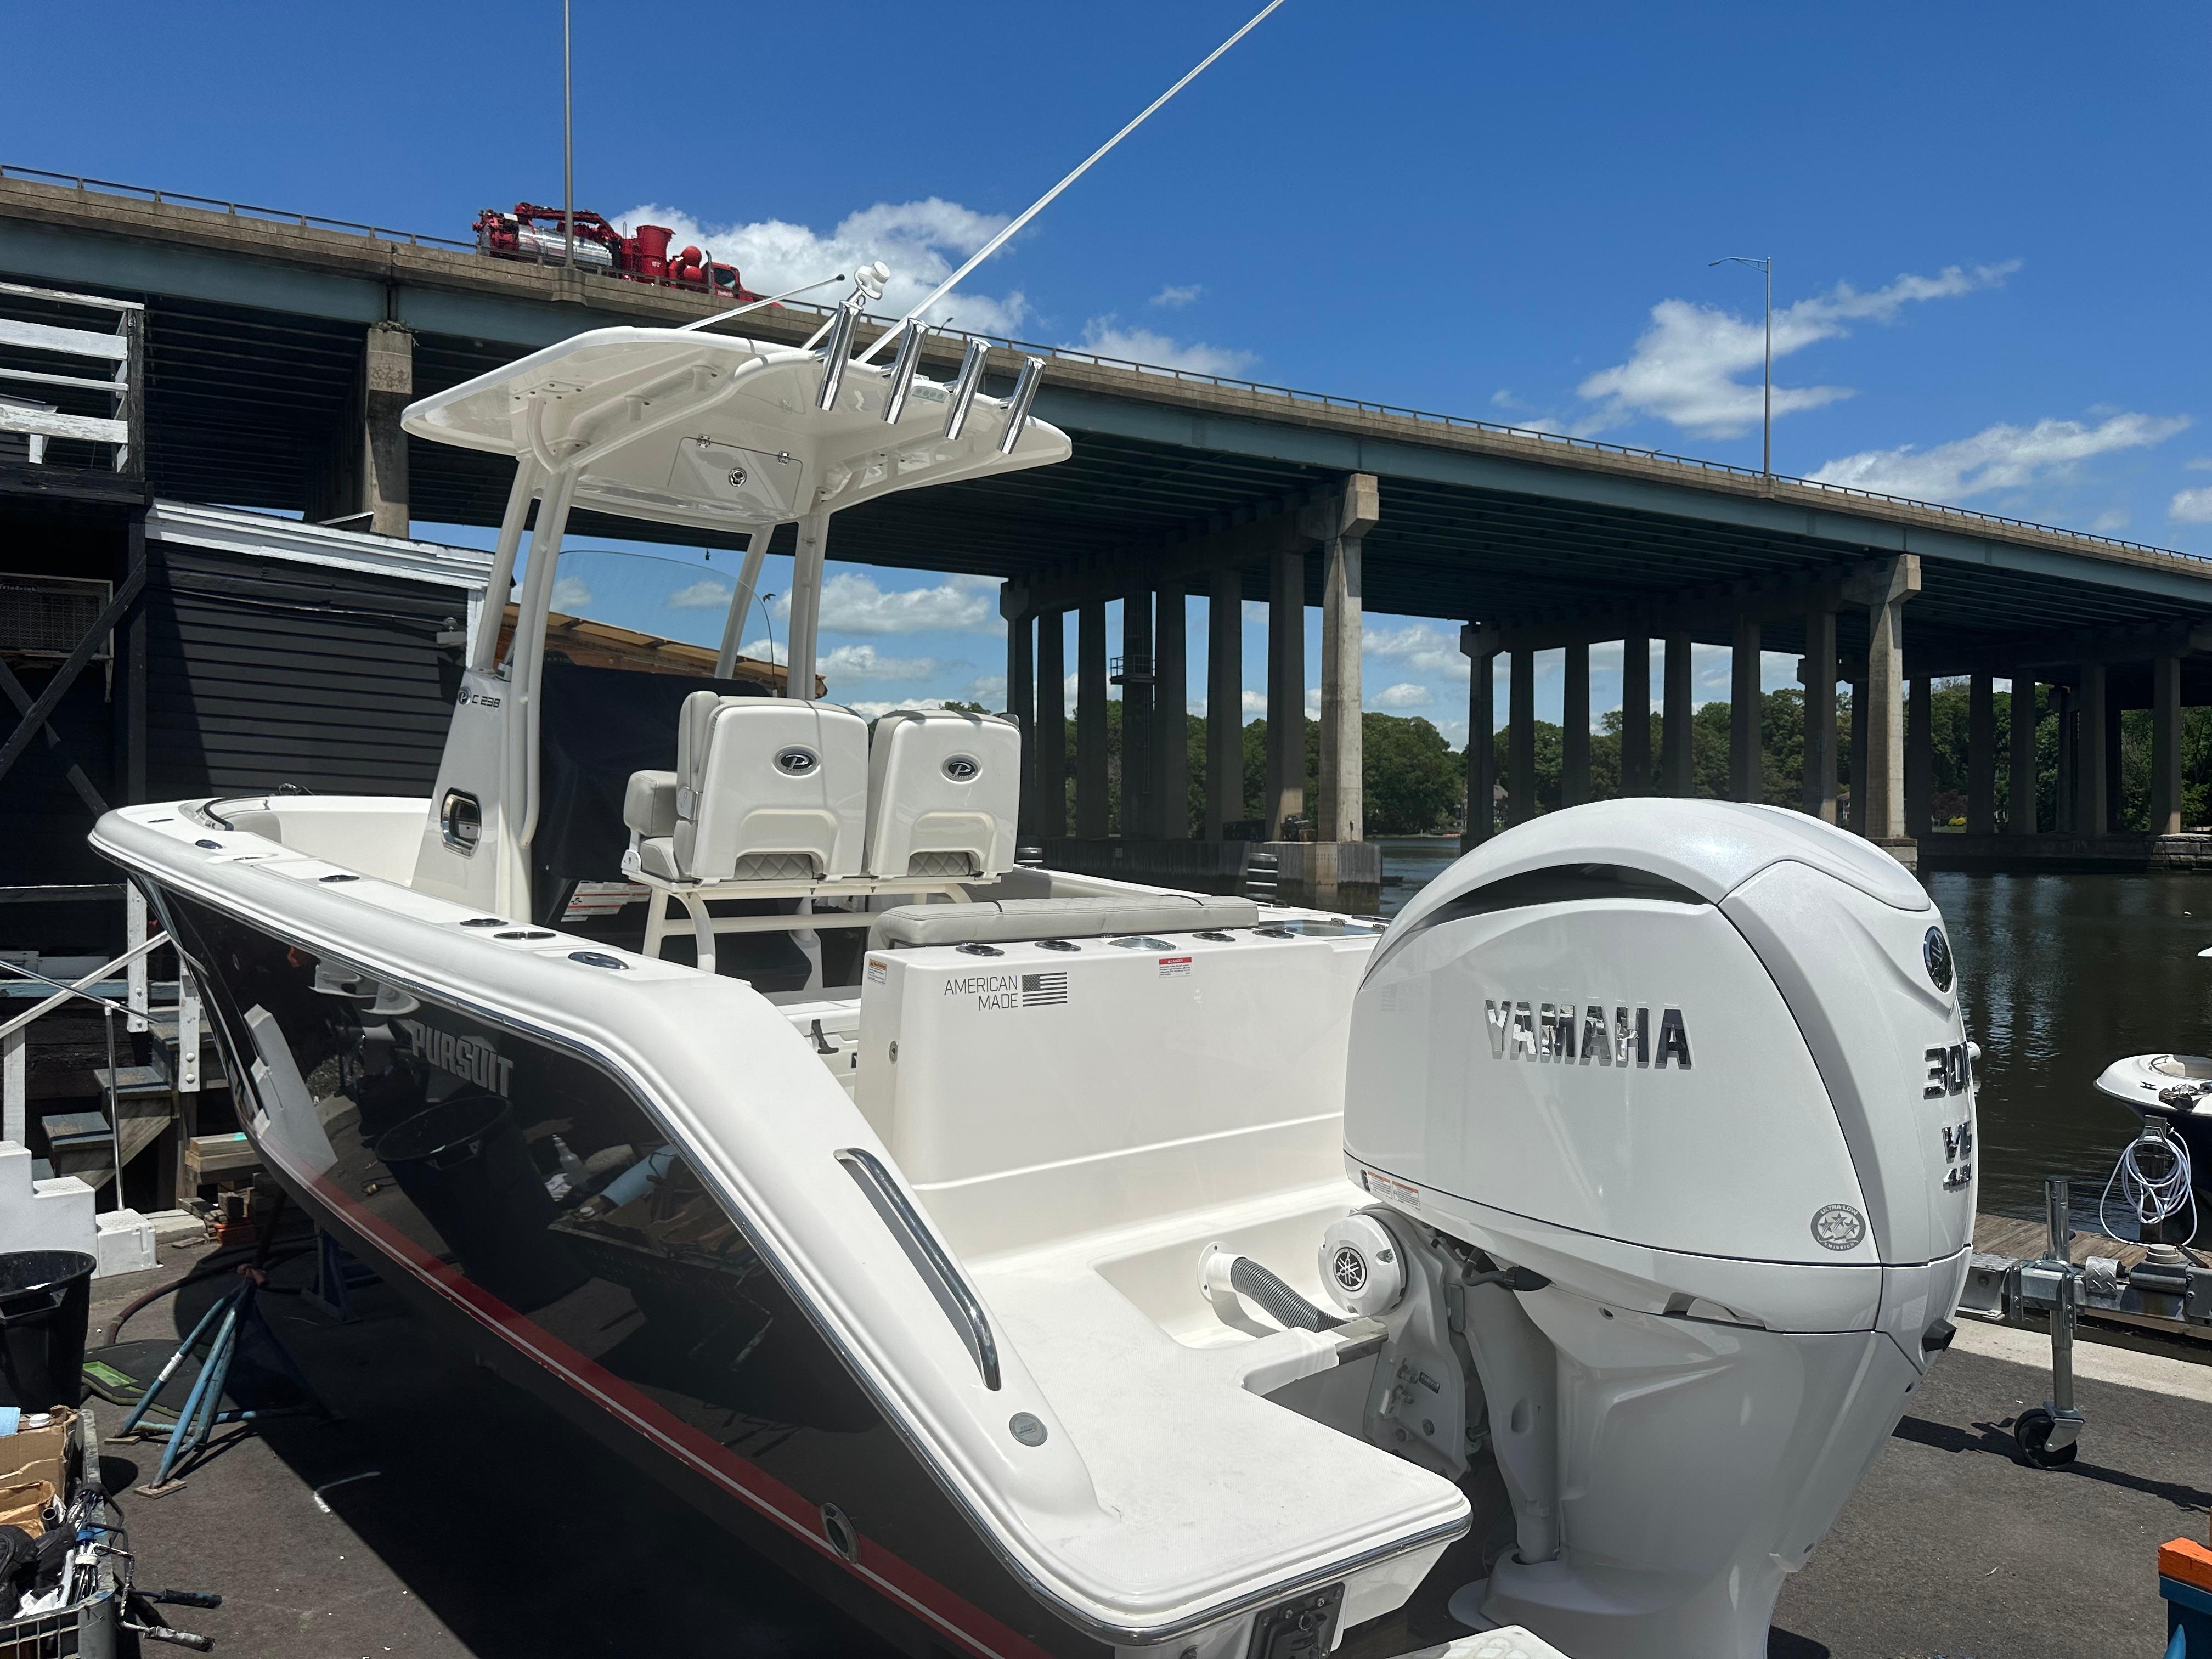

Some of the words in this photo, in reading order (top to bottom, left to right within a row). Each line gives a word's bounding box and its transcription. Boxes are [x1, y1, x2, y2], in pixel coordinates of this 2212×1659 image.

[472, 695, 479, 704] C
[481, 696, 500, 708] 238
[944, 975, 1018, 996] AMERICAN
[979, 993, 1018, 1011] MADE
[1484, 999, 1692, 1070] YAMAHA
[411, 1019, 514, 1098] PURSUIT
[1824, 1242, 1854, 1250] EMISSION
